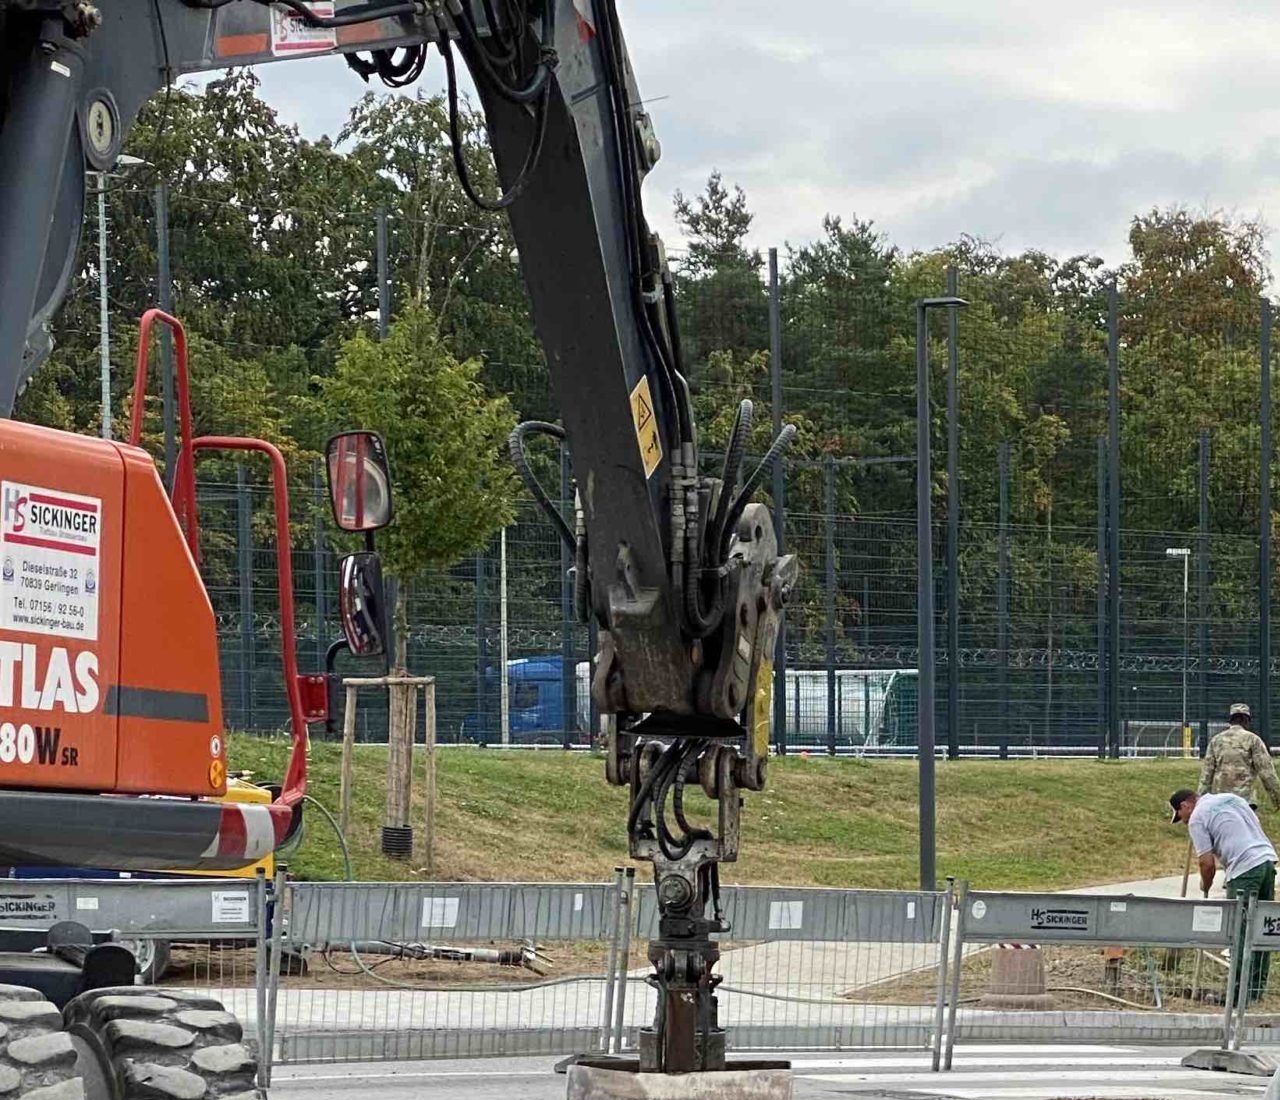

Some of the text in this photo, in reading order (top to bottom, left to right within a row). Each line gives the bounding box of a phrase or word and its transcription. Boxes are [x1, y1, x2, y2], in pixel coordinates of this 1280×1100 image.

[30, 504, 97, 534] SICKINGER
[22, 561, 78, 579] Dieselstraße 32
[21, 577, 79, 596] 70839 Gerlingen
[1046, 915, 1087, 924] SICKINGER
